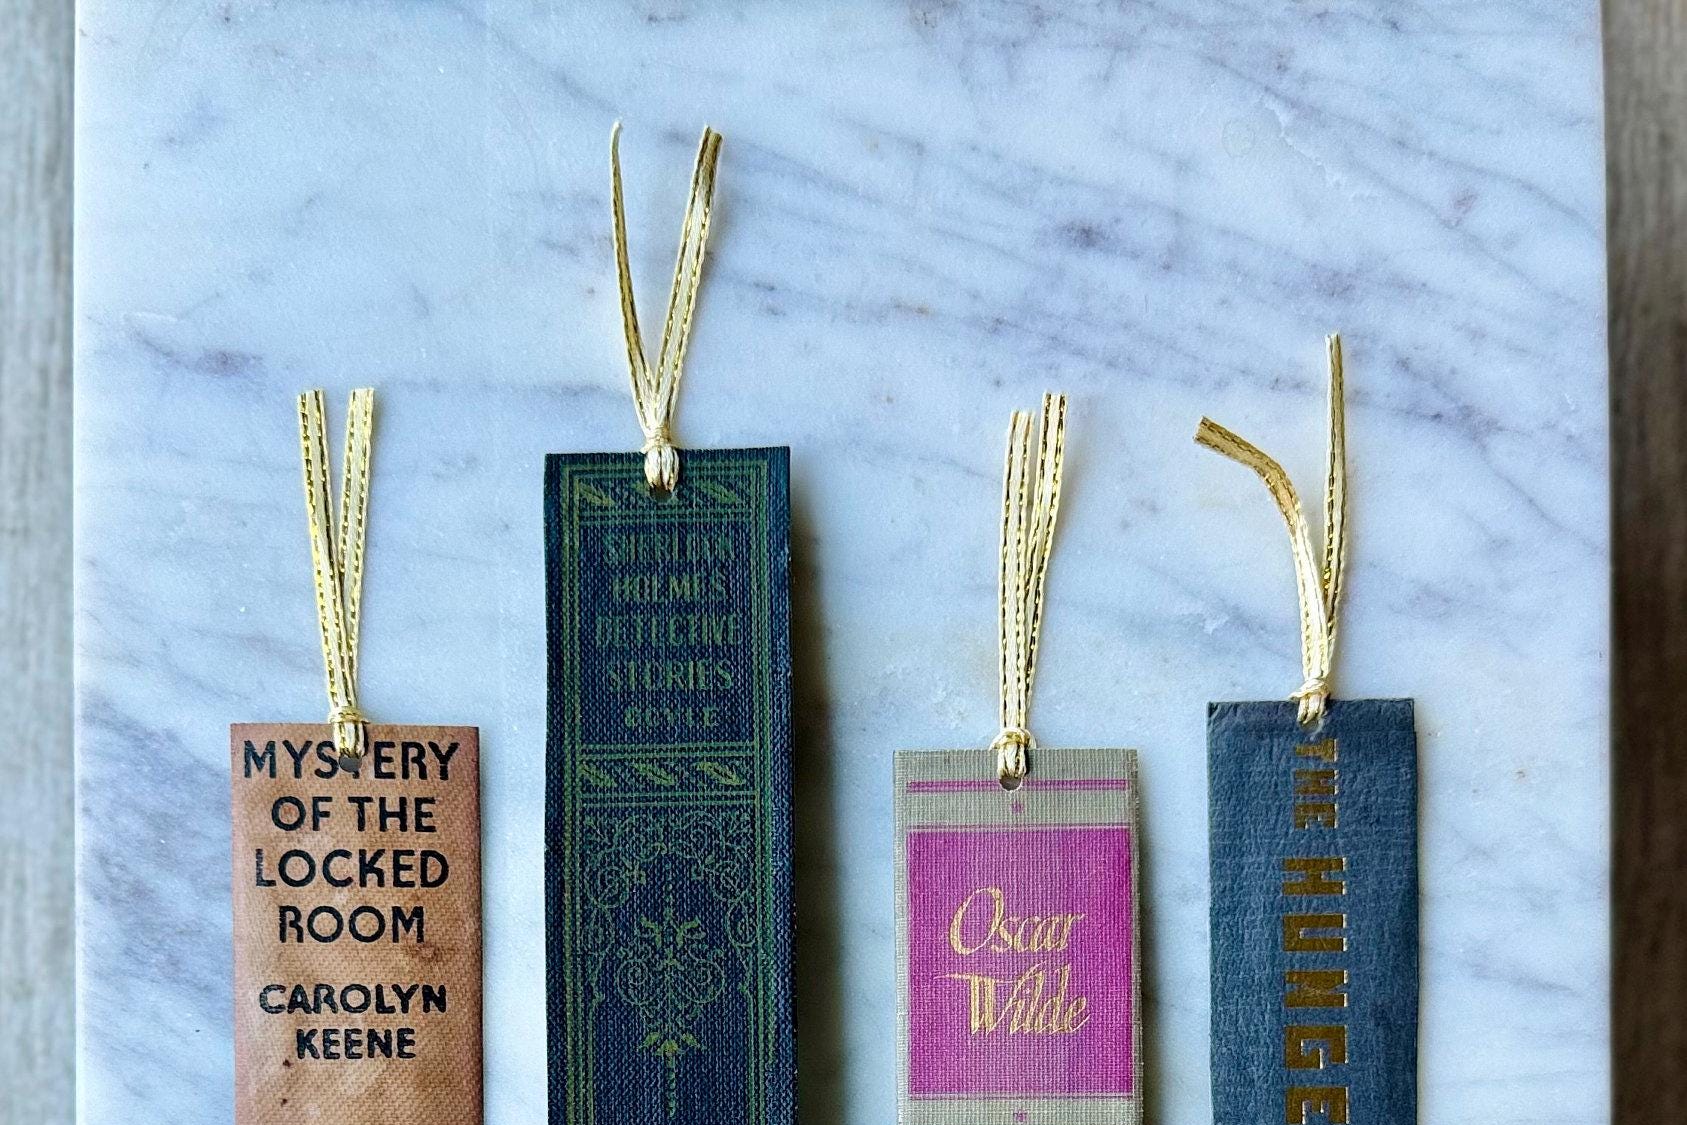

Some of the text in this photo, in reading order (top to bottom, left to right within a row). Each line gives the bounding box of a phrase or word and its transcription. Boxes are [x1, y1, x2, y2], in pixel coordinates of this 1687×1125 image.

[611, 571, 729, 602] HOLMES
[595, 613, 743, 647] DETECTIVE
[606, 659, 734, 692] STORIES
[243, 739, 460, 781] MYSERY
[1293, 738, 1338, 829] THE
[271, 796, 437, 832] OF THE
[255, 849, 450, 888] LOCKED
[278, 905, 425, 943] ROOM
[949, 887, 1086, 955] Oscar
[259, 983, 448, 1014] CAROLYN
[933, 960, 1092, 1036] Wilde
[296, 1027, 417, 1060] KEENE
